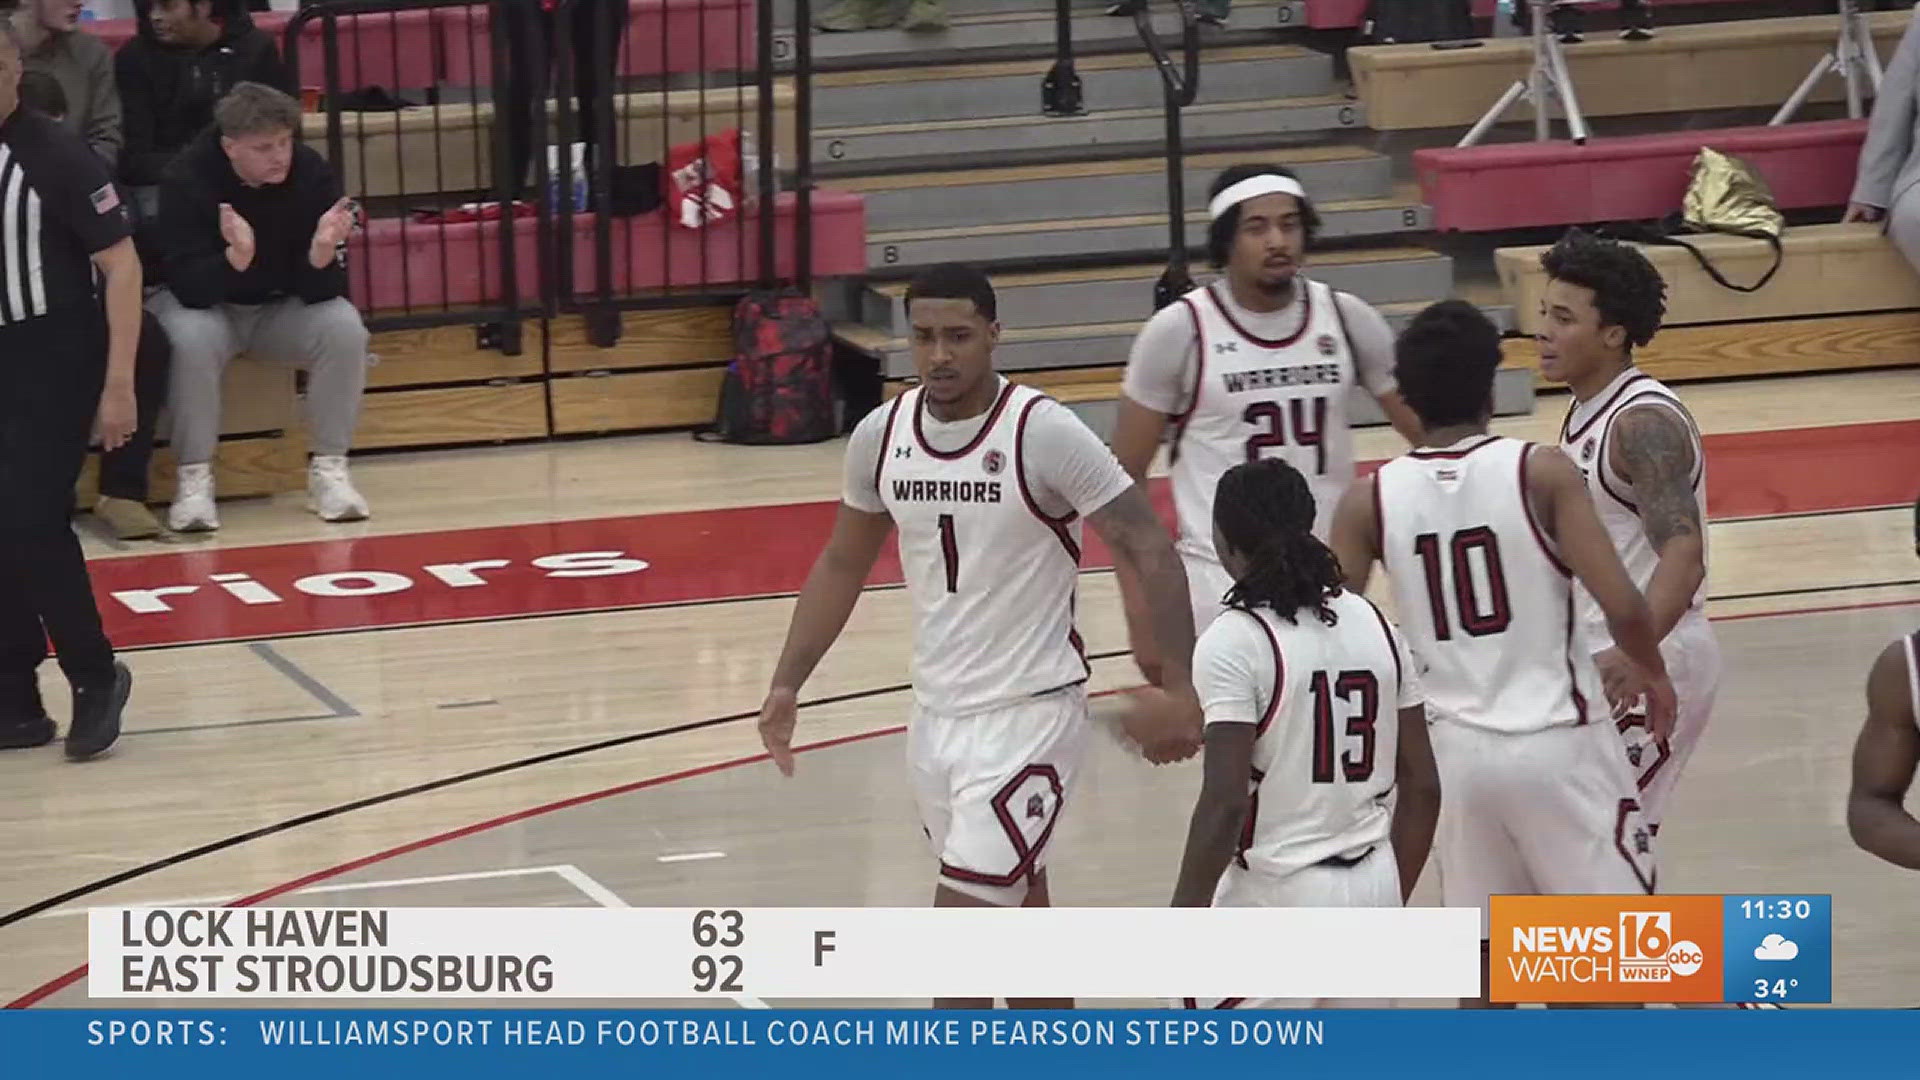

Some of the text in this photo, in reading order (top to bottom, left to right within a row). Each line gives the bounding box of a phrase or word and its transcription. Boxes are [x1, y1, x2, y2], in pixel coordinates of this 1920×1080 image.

[1278, 6, 1293, 23] D
[1338, 107, 1354, 125] C
[828, 140, 845, 159] C
[1402, 209, 1417, 227] B
[883, 245, 899, 264] B
[1222, 362, 1341, 393] WARRIORS
[1242, 396, 1329, 476] 24
[892, 479, 1002, 504] WARRIORS
[937, 513, 960, 593] 1
[1415, 525, 1512, 641] 10
[1309, 669, 1379, 784] 13
